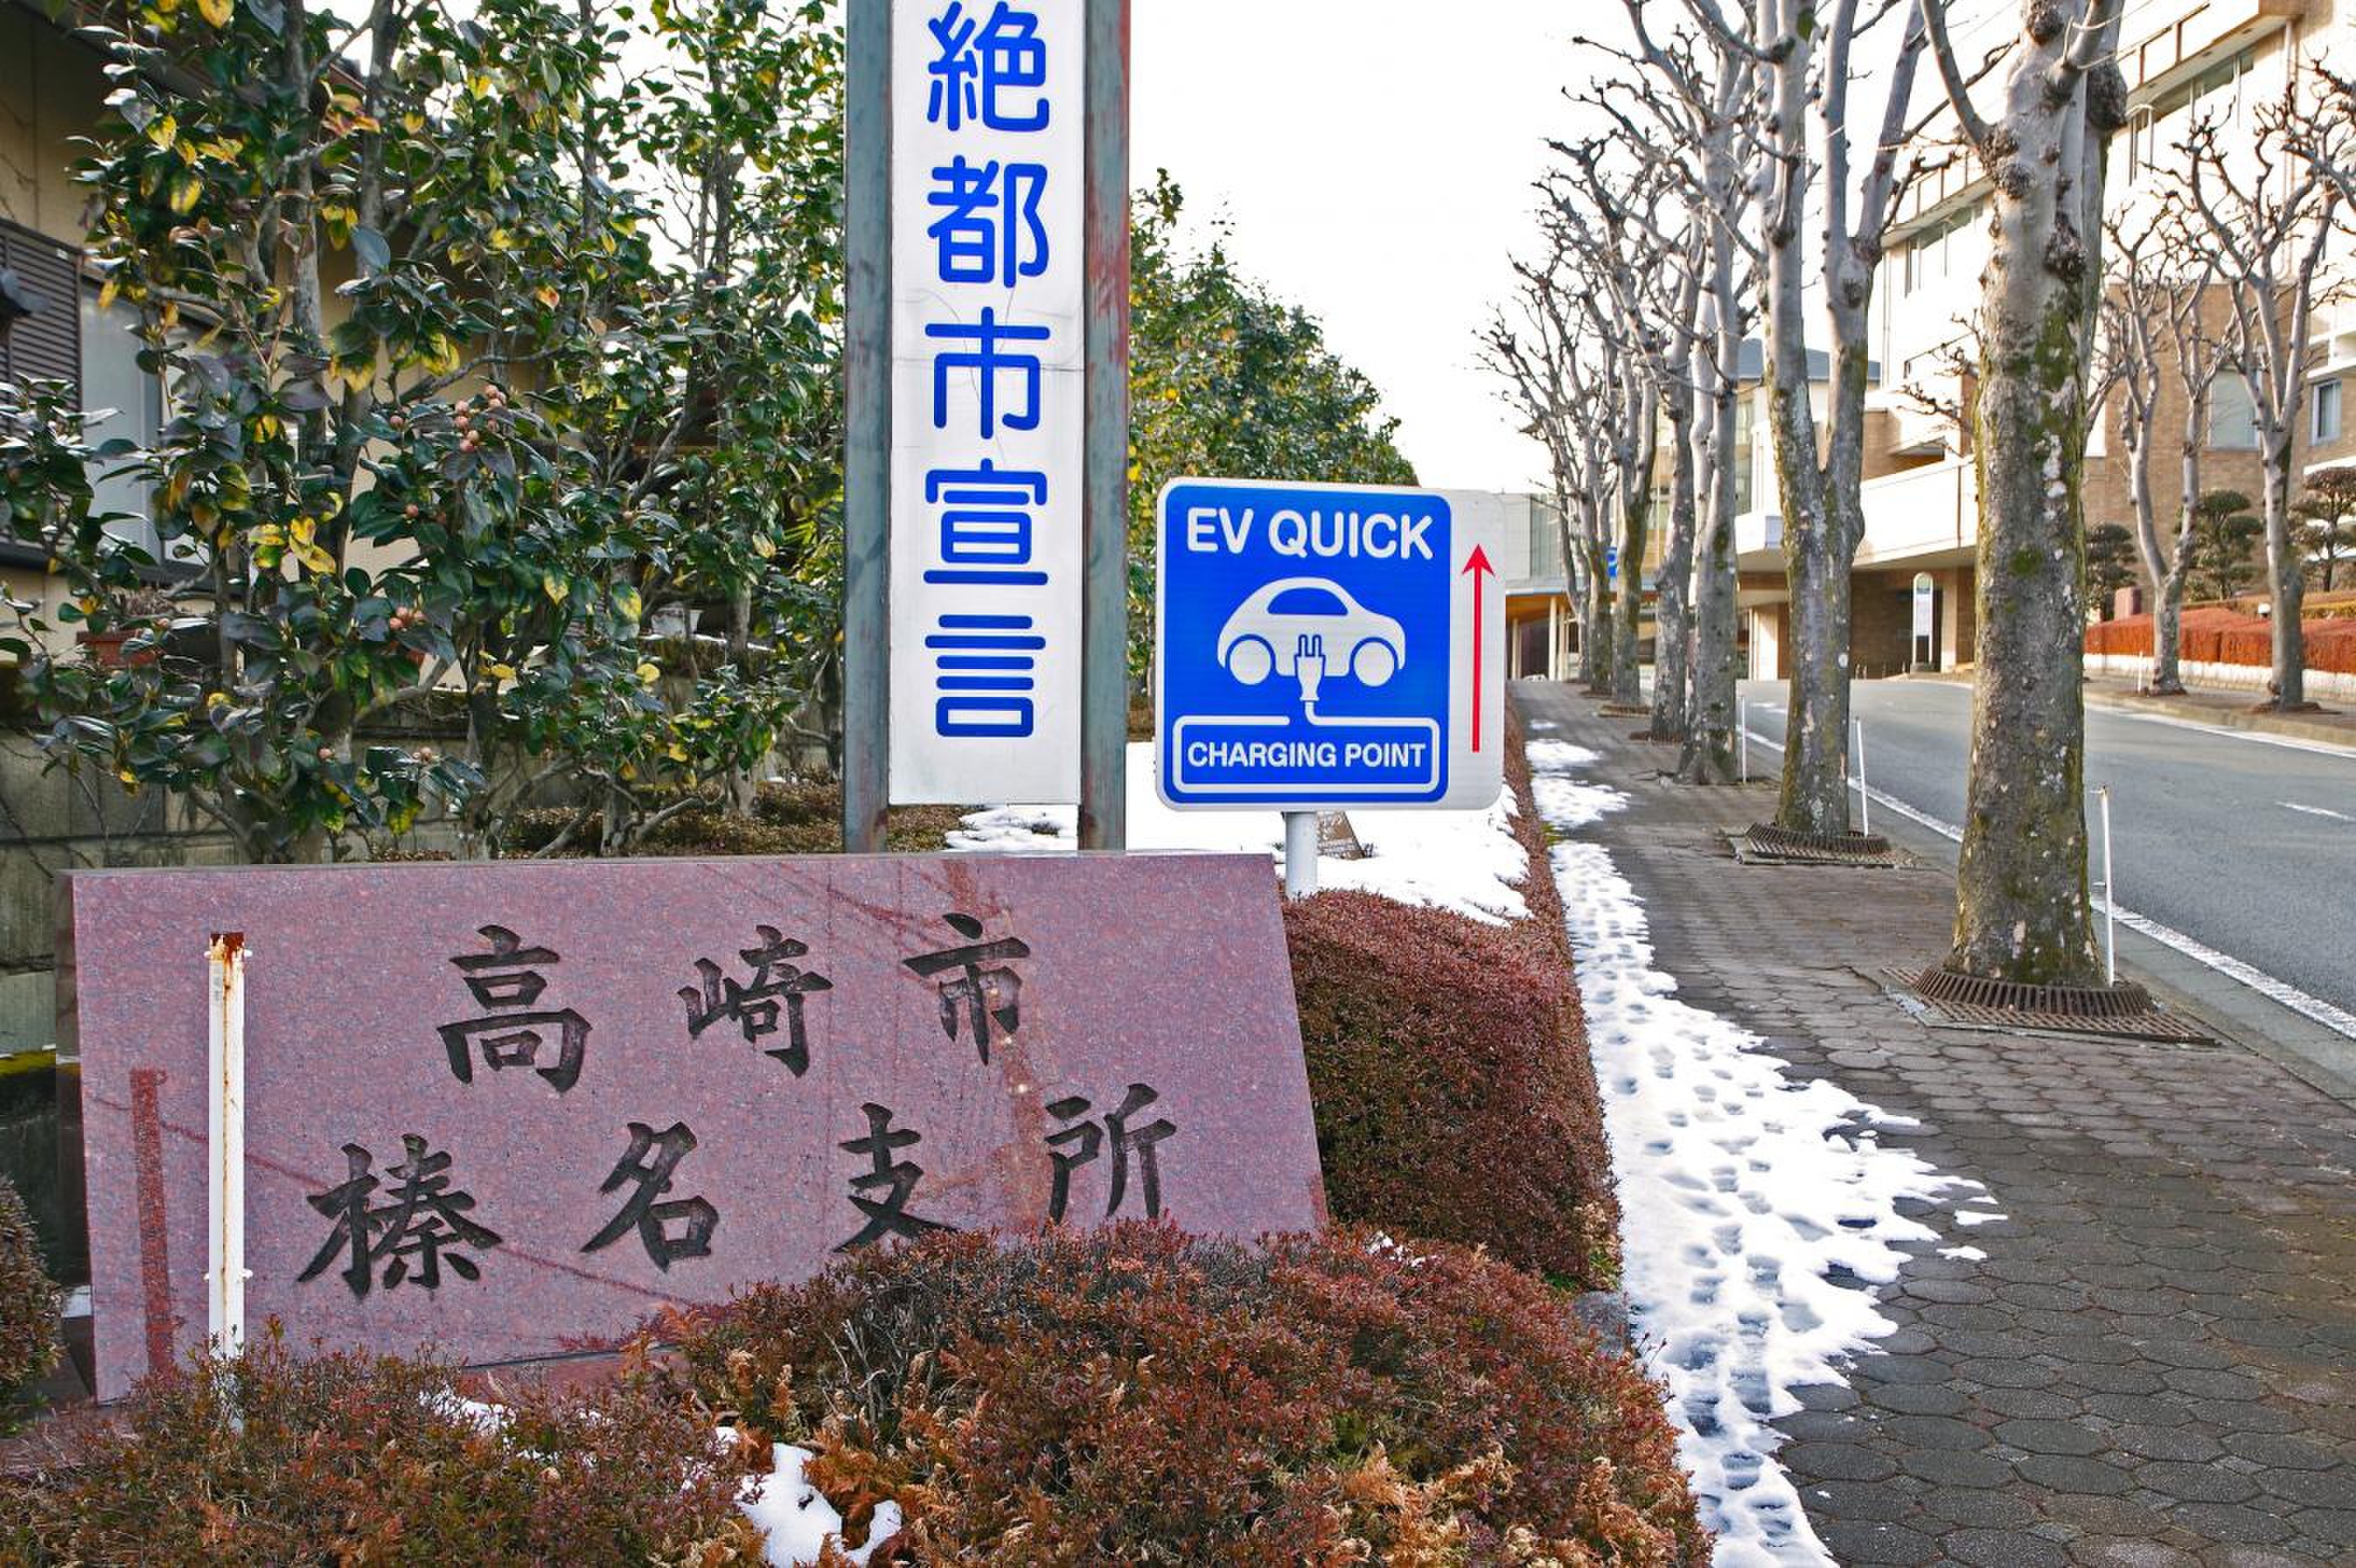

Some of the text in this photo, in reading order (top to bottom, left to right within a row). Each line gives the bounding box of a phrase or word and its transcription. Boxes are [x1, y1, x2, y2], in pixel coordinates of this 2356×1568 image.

[924, 1, 1051, 738] 絶都市宣言
[1187, 507, 1434, 559] EV QUICK
[1187, 740, 1426, 768] CHARGING POINT
[436, 912, 1032, 1093] 高崎市
[298, 1083, 1177, 1301] 榛名支所
